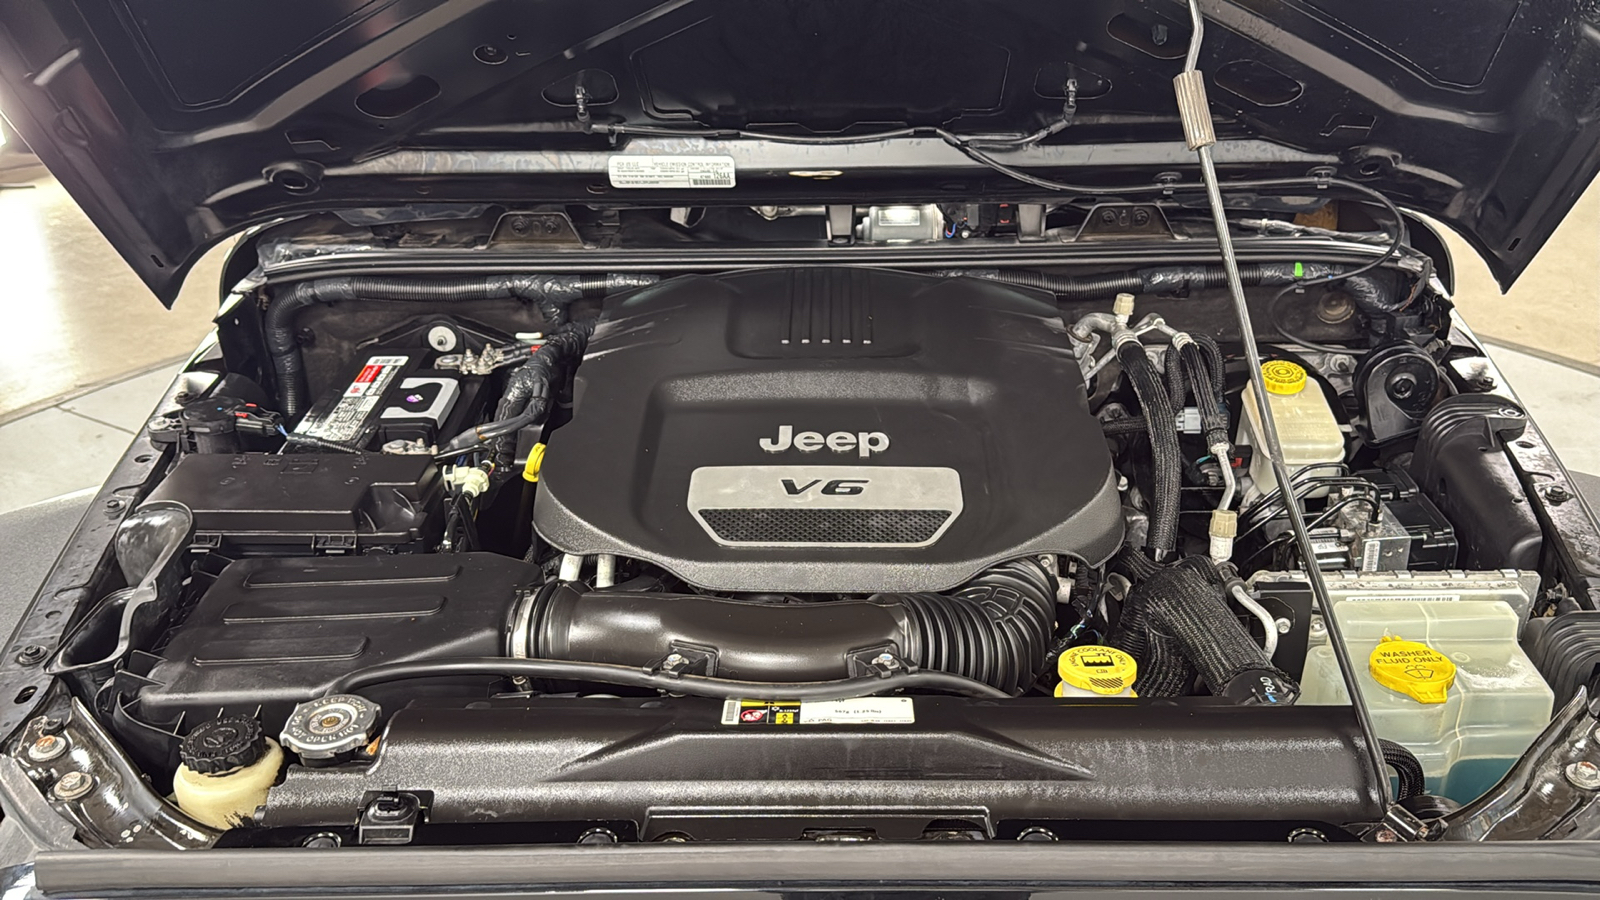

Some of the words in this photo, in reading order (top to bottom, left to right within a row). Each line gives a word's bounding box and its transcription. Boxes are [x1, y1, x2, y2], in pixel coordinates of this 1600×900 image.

[759, 425, 890, 459] Jeep
[780, 479, 871, 496] V6
[1379, 650, 1432, 658] WASHER
[1115, 654, 1127, 666] ONLY
[1375, 657, 1410, 665] FLUID
[1413, 656, 1443, 664] ONLY
[306, 735, 337, 743] OPEN
